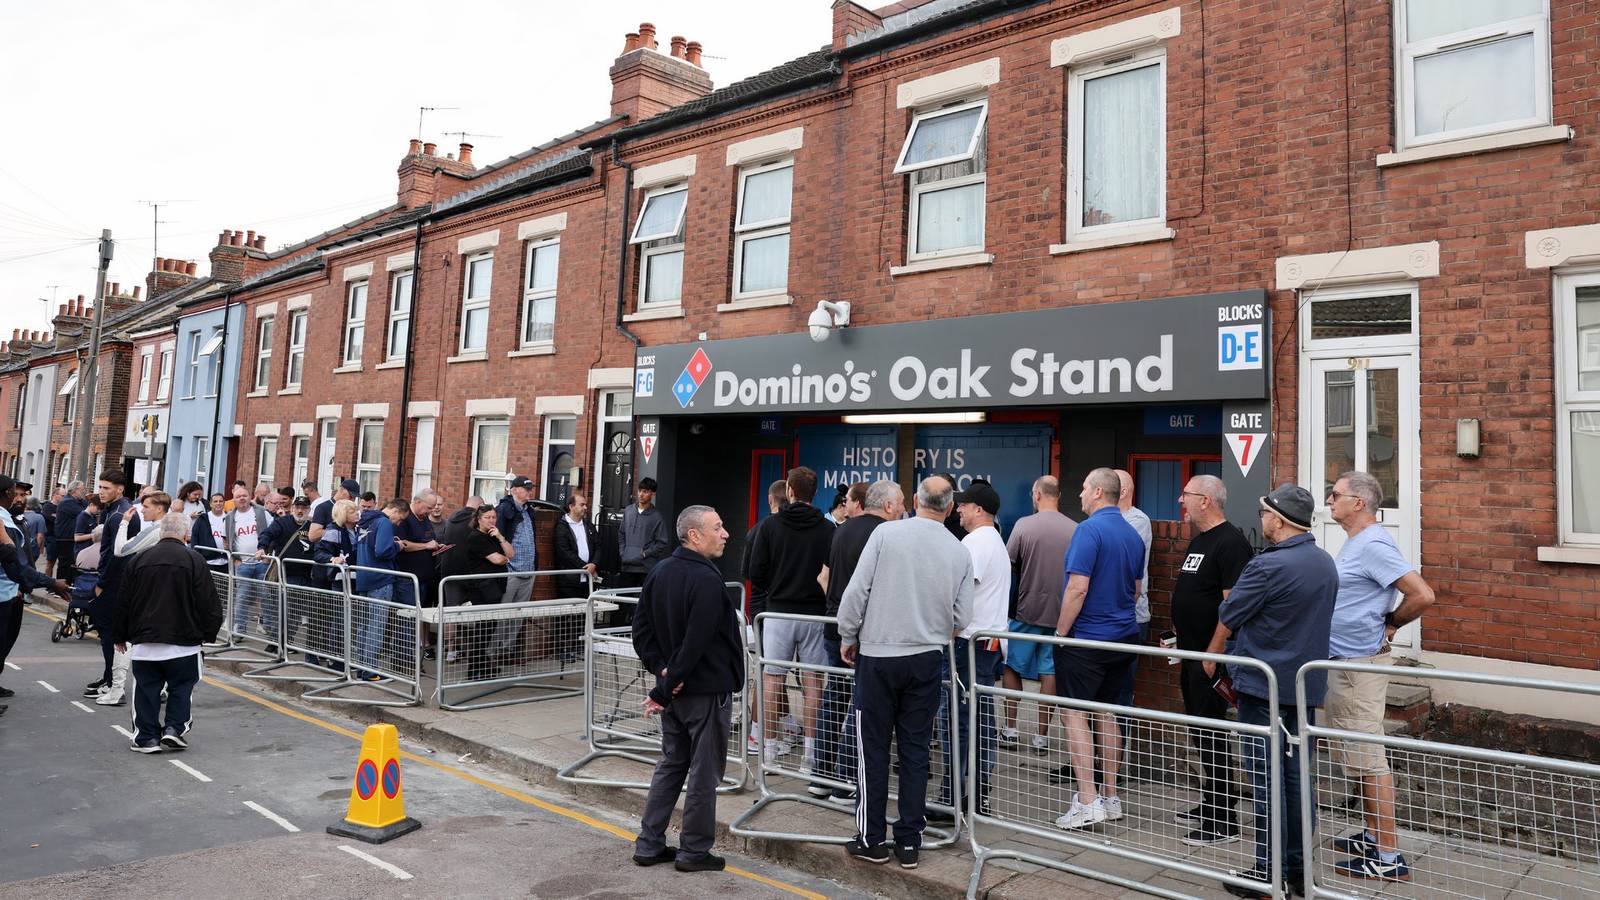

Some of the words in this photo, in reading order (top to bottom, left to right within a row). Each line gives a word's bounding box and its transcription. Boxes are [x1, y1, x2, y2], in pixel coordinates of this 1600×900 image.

[1218, 304, 1263, 322] BLOCKS
[637, 355, 656, 366] BLOCKS
[888, 348, 992, 401] Oak
[1008, 334, 1174, 398] Stand
[642, 423, 656, 433] GATE
[761, 420, 777, 431] GATE
[1169, 414, 1195, 428] GATE
[1231, 413, 1262, 428] GATE
[644, 437, 652, 457] 6
[1238, 435, 1253, 466] 7
[946, 448, 965, 470] IS
